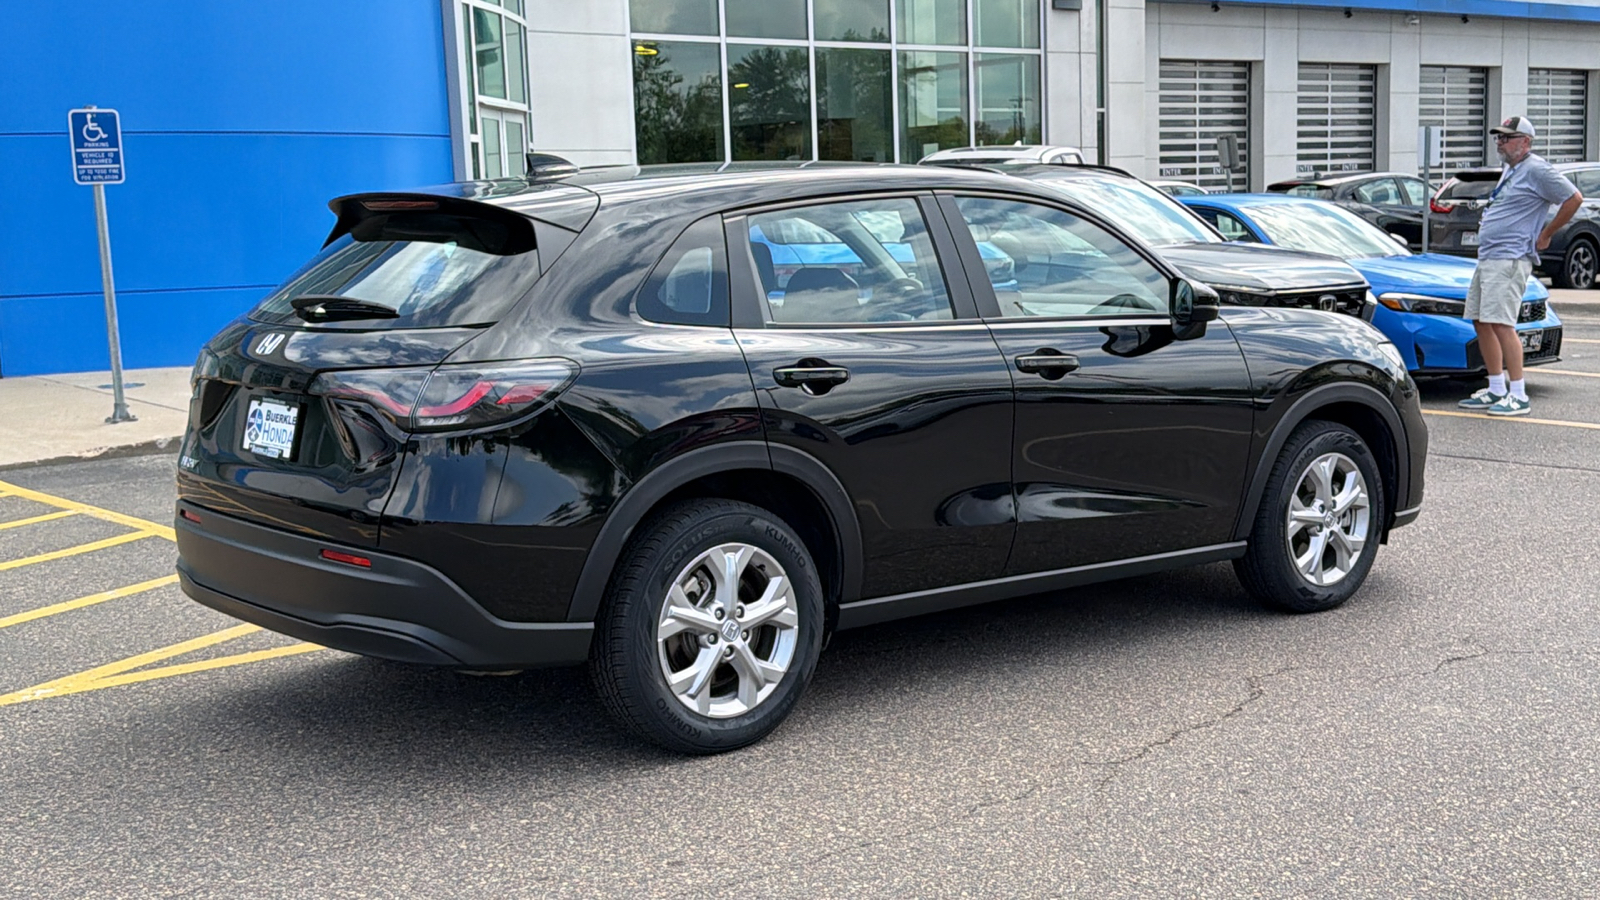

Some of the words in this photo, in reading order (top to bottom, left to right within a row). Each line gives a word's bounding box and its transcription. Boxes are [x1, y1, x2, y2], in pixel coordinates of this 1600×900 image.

[261, 422, 293, 446] HONDA
[265, 409, 298, 426] BUERKLE
[663, 525, 714, 573] SOLUS
[764, 524, 807, 569] KUMHO
[655, 697, 702, 739] KUMHO
